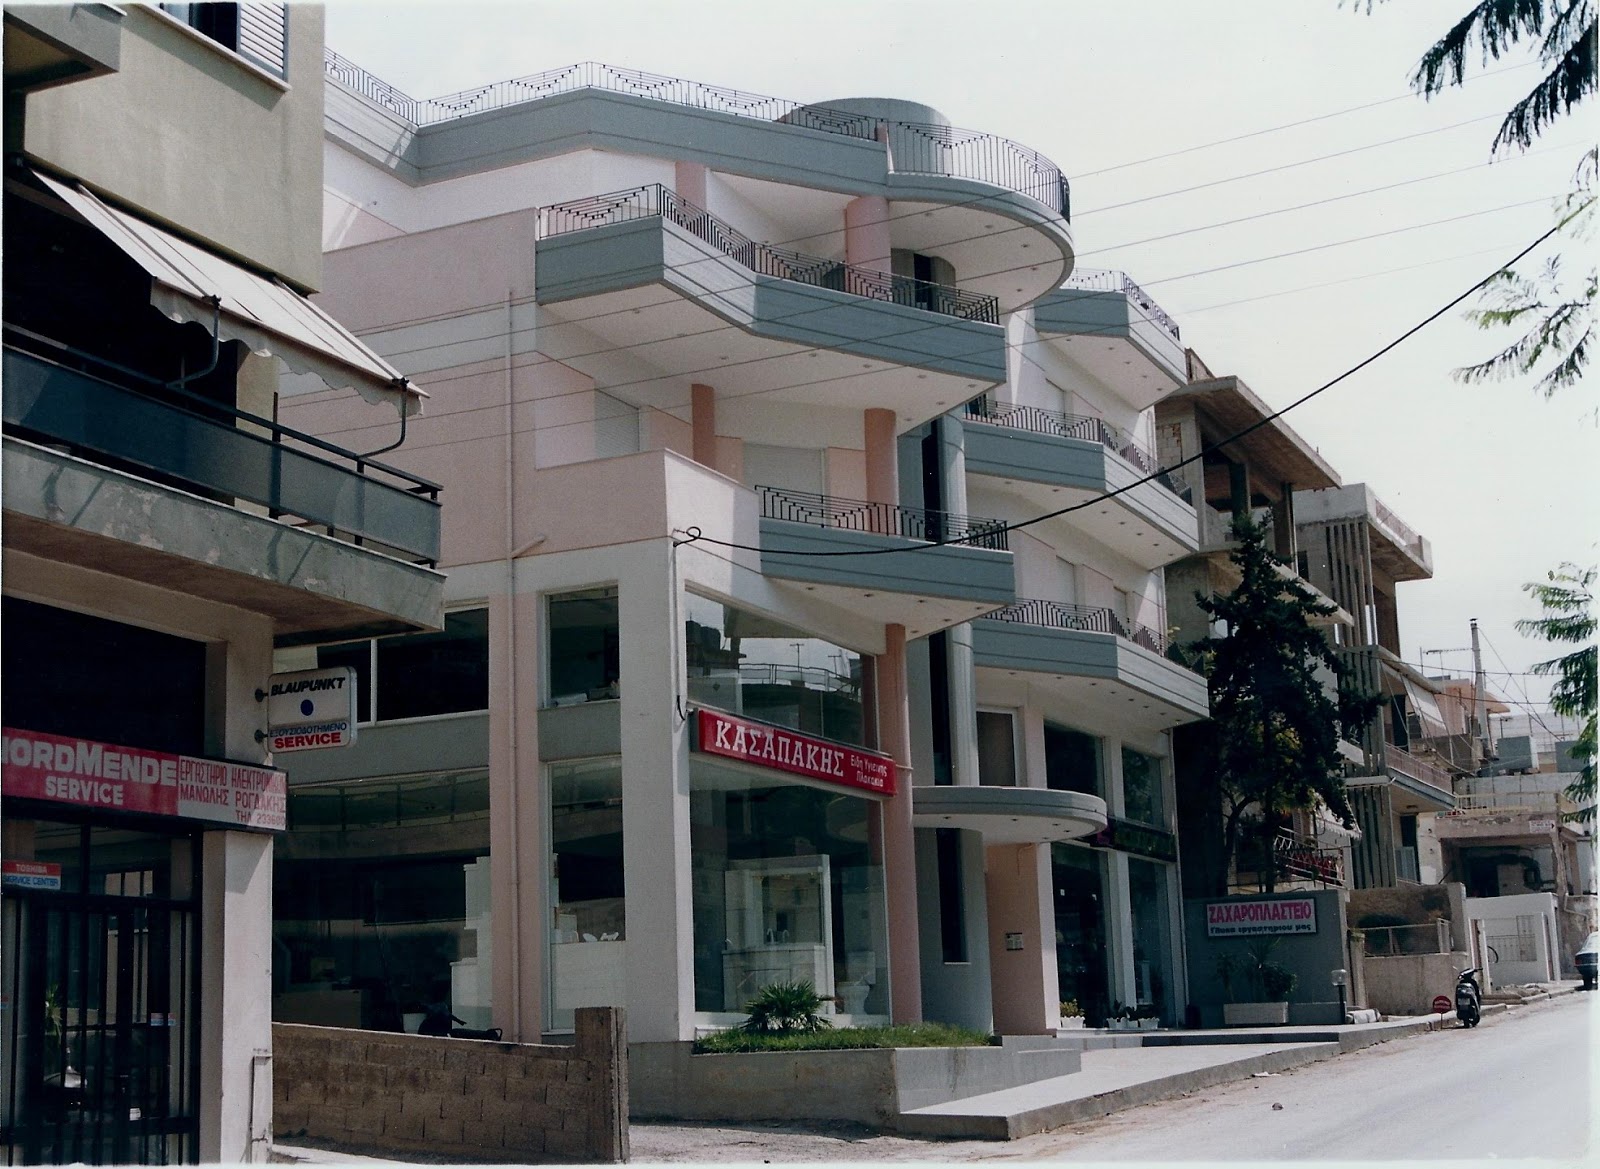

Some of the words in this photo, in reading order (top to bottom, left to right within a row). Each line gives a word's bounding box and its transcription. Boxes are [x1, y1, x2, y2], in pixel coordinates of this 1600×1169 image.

[270, 677, 345, 696] BLAUPUNKT
[274, 732, 341, 749] SERVICE
[715, 719, 844, 777] ΚΑΣΑΠΑΚΗΣ
[180, 759, 227, 786] ΕΡΓΑΣΤΗΡΙΟ
[45, 776, 124, 805] SERVICE
[180, 783, 229, 805] ΜΑΝΩΛΗΣ
[15, 863, 48, 874] TOSHIBA
[32, 877, 59, 887] CENTER
[1209, 902, 1311, 923] ΖΑΧΑΡΟΠΛΑΣΤΕΙΟ
[1296, 924, 1311, 932] μας
